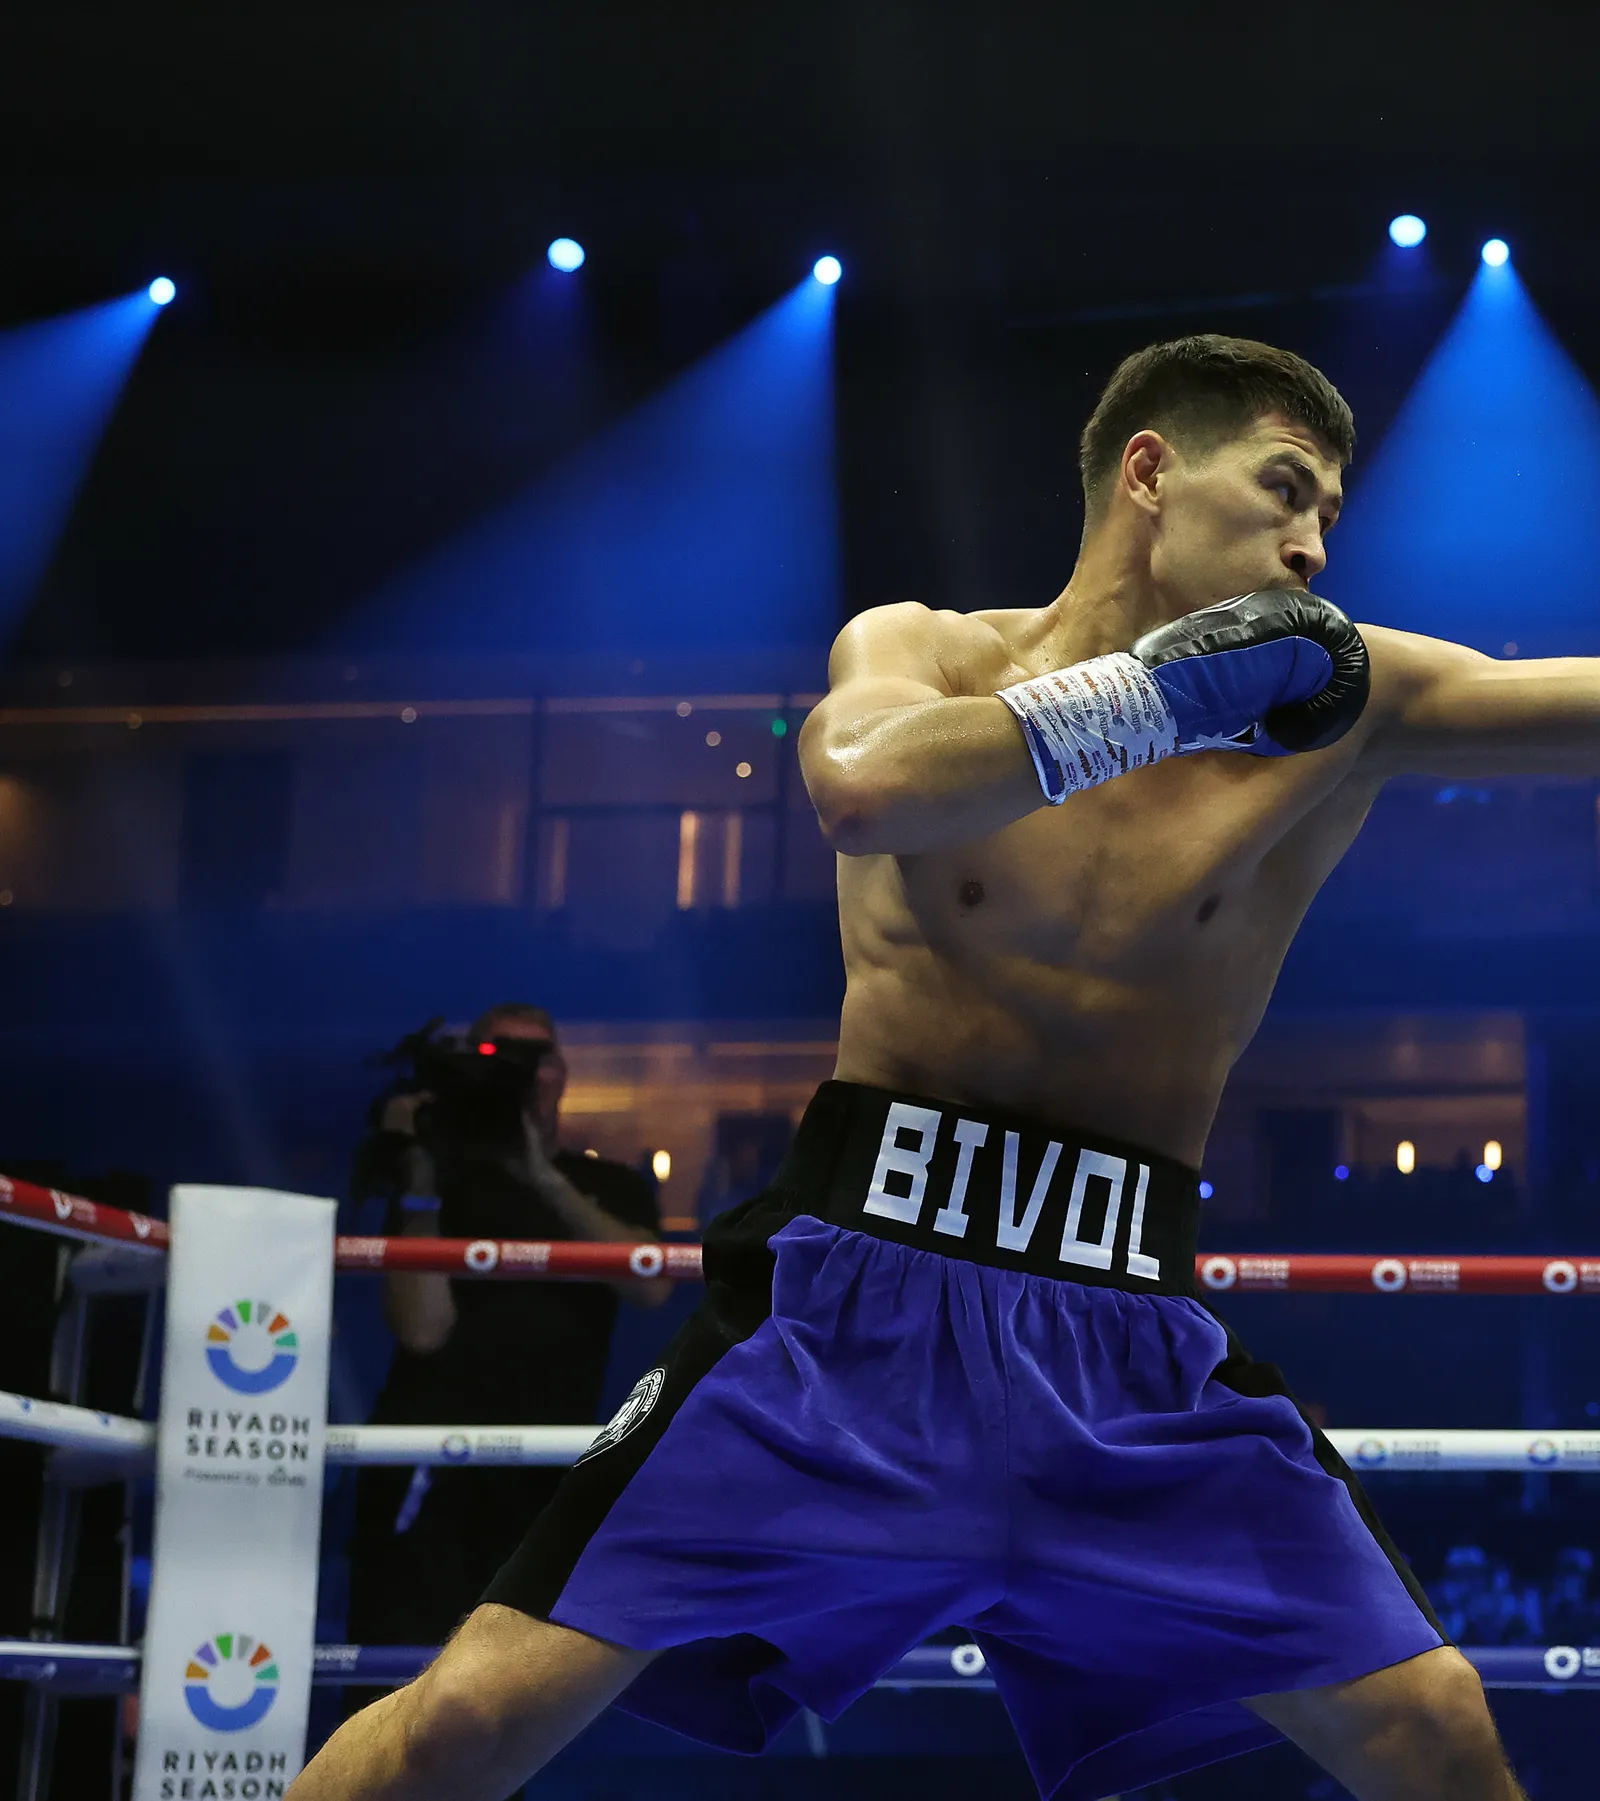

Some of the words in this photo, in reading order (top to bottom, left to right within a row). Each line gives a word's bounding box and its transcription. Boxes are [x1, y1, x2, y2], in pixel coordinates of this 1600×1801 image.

[863, 1101, 1160, 1281] BIVOL
[187, 1407, 310, 1436] RIYADH
[186, 1433, 308, 1461] SEASON
[163, 1749, 287, 1774] RIYADH
[160, 1777, 285, 1800] SEASON
